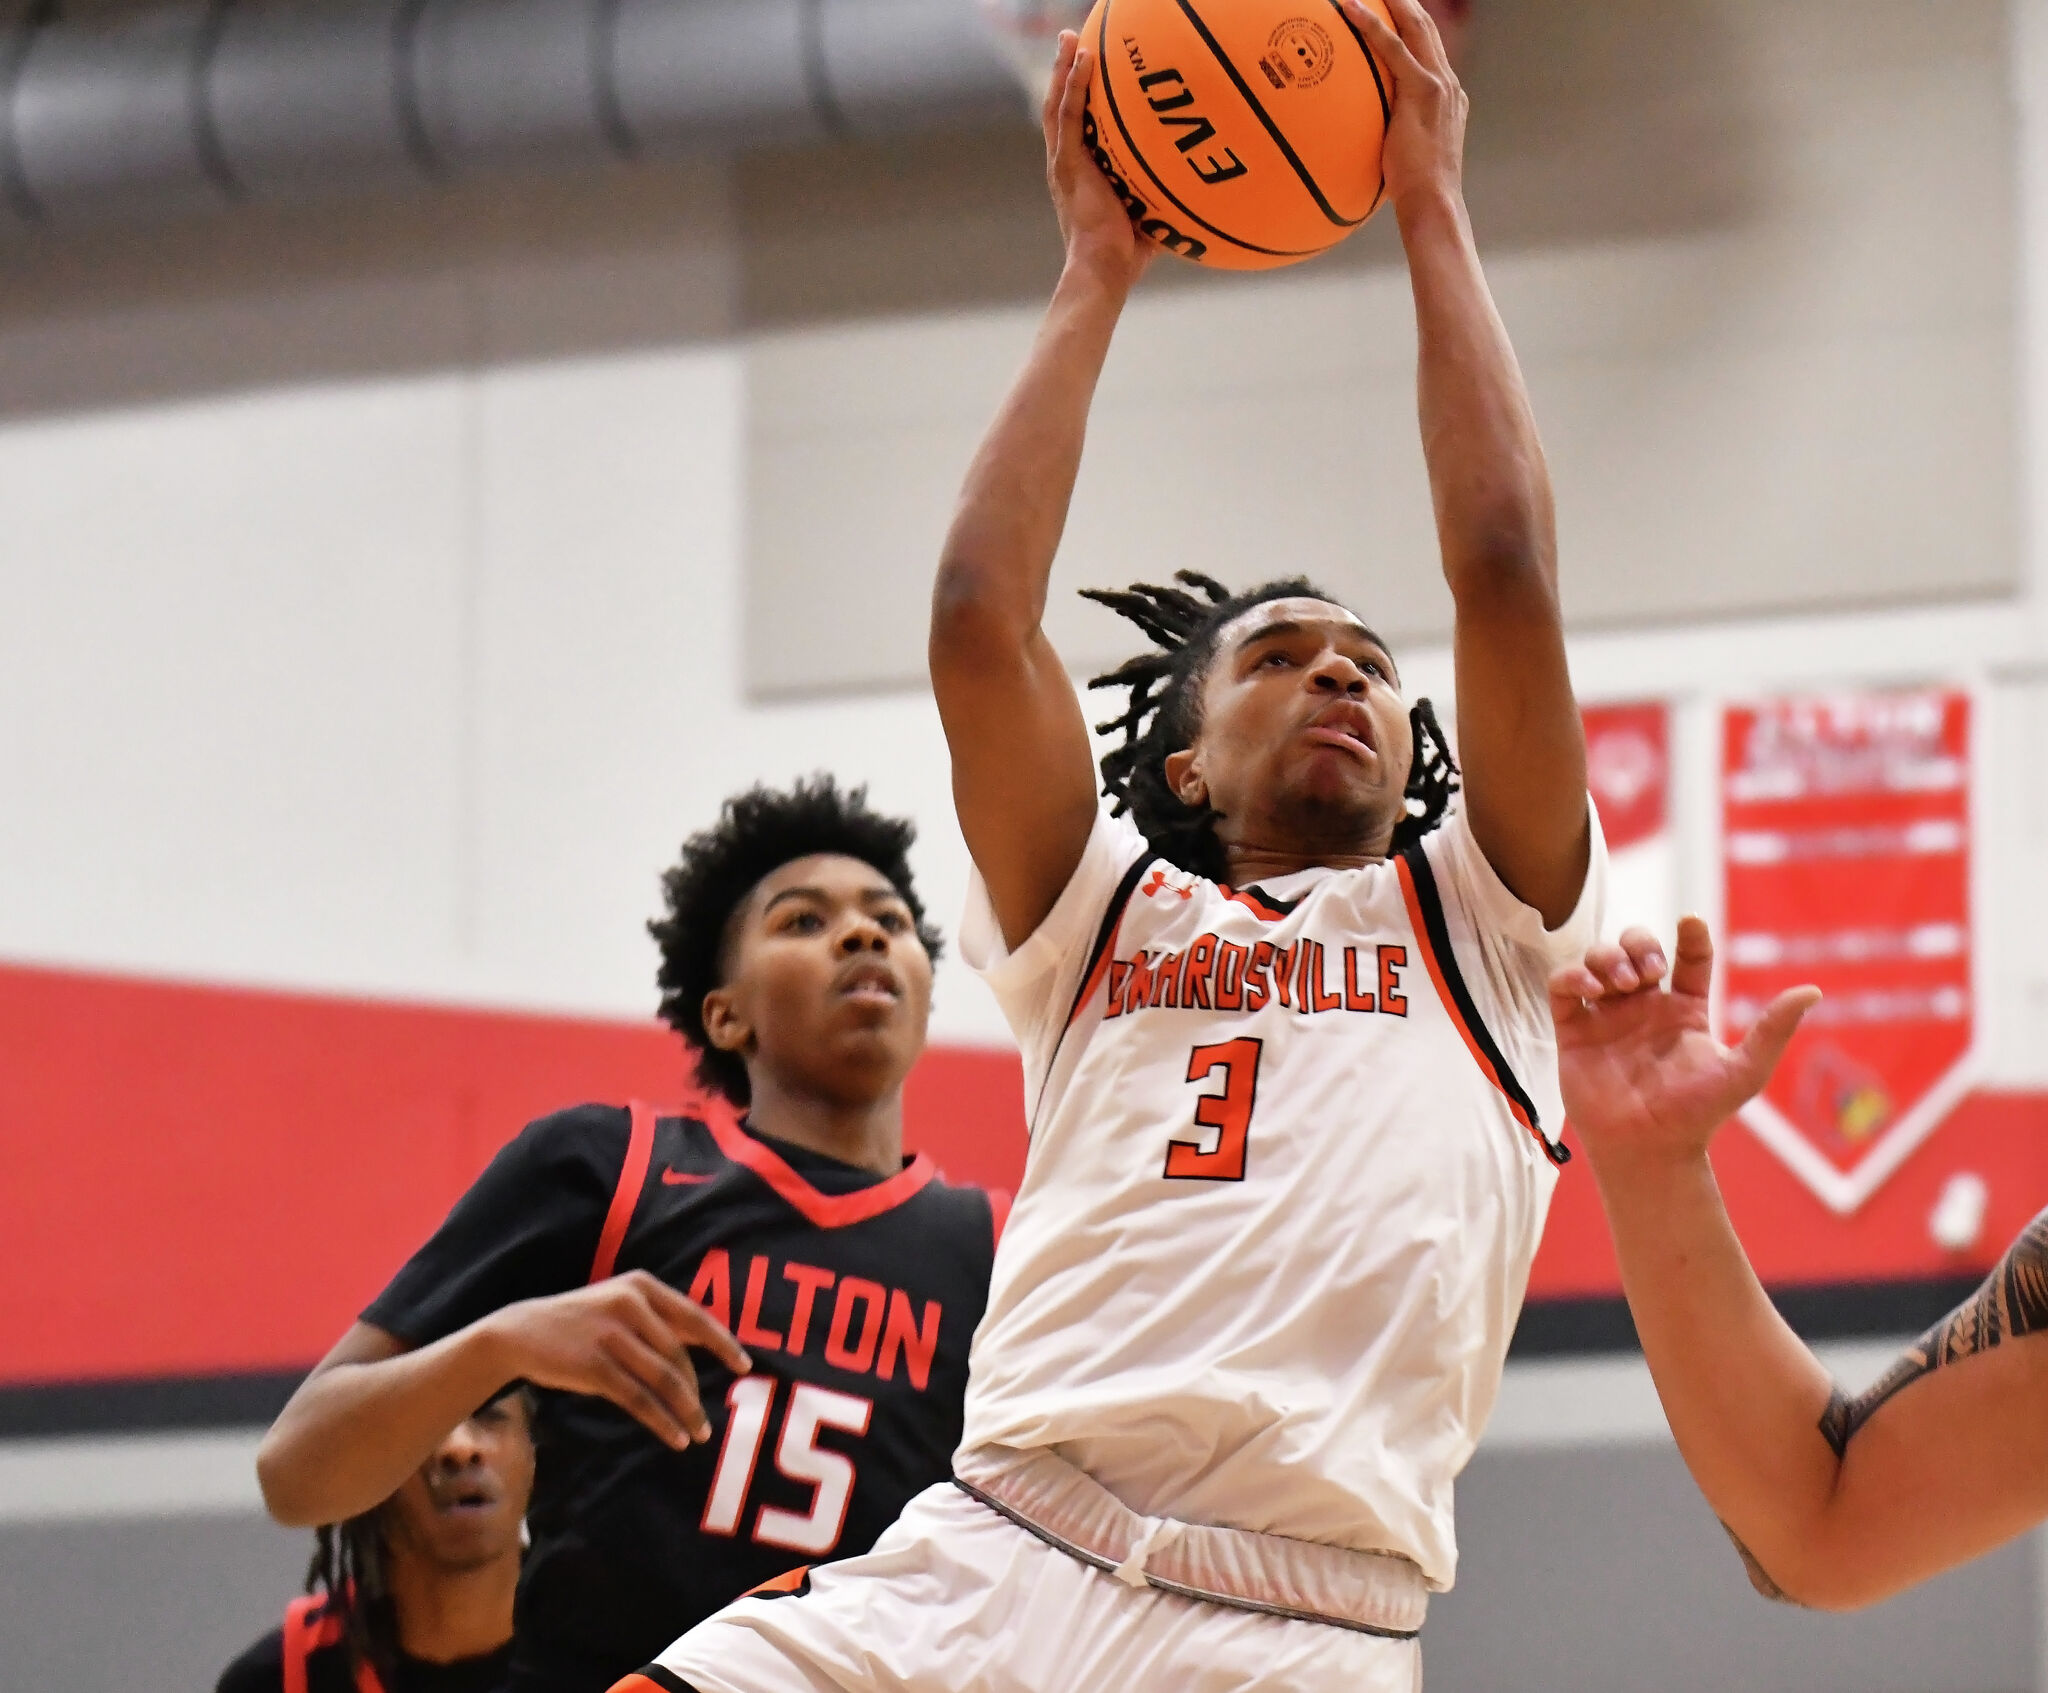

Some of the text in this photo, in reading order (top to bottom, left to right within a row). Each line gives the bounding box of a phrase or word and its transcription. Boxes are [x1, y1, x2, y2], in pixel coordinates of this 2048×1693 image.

[1123, 37, 1147, 72] NXT
[1138, 68, 1248, 184] EVO
[1163, 1036, 1263, 1182] 3
[687, 1246, 943, 1392] ALTON
[699, 1372, 874, 1557] 15
